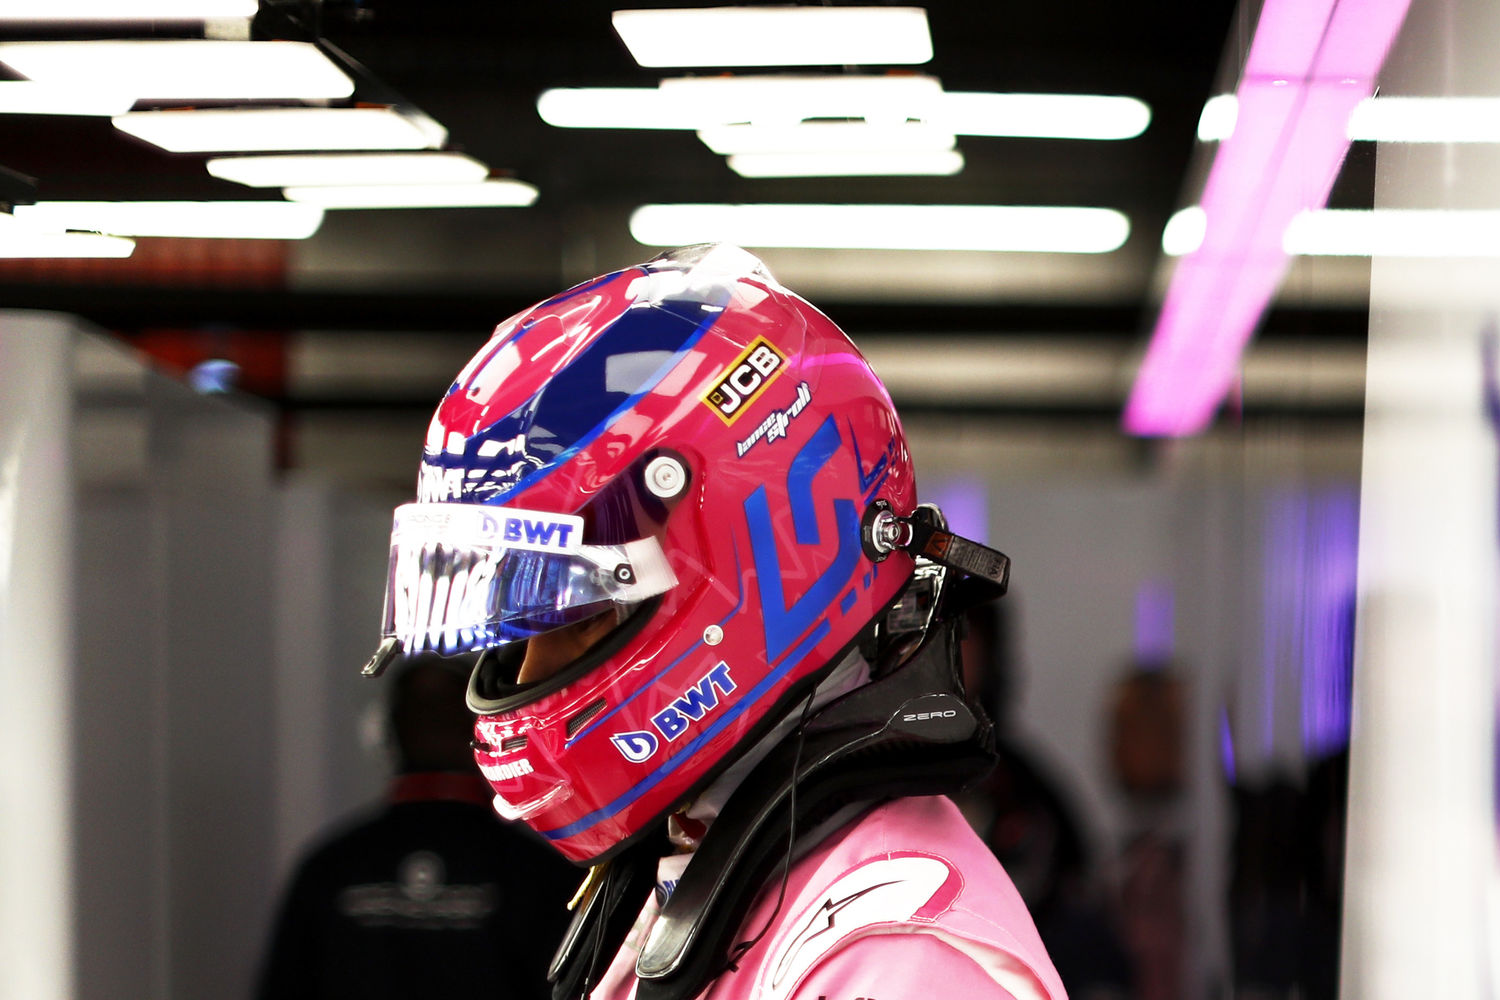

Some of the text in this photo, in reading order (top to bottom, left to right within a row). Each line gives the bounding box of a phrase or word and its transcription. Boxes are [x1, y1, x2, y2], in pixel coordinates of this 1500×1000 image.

[719, 345, 781, 414] JCB
[503, 517, 574, 548] BWT
[649, 659, 738, 743] BWT
[903, 709, 957, 722] ZERO
